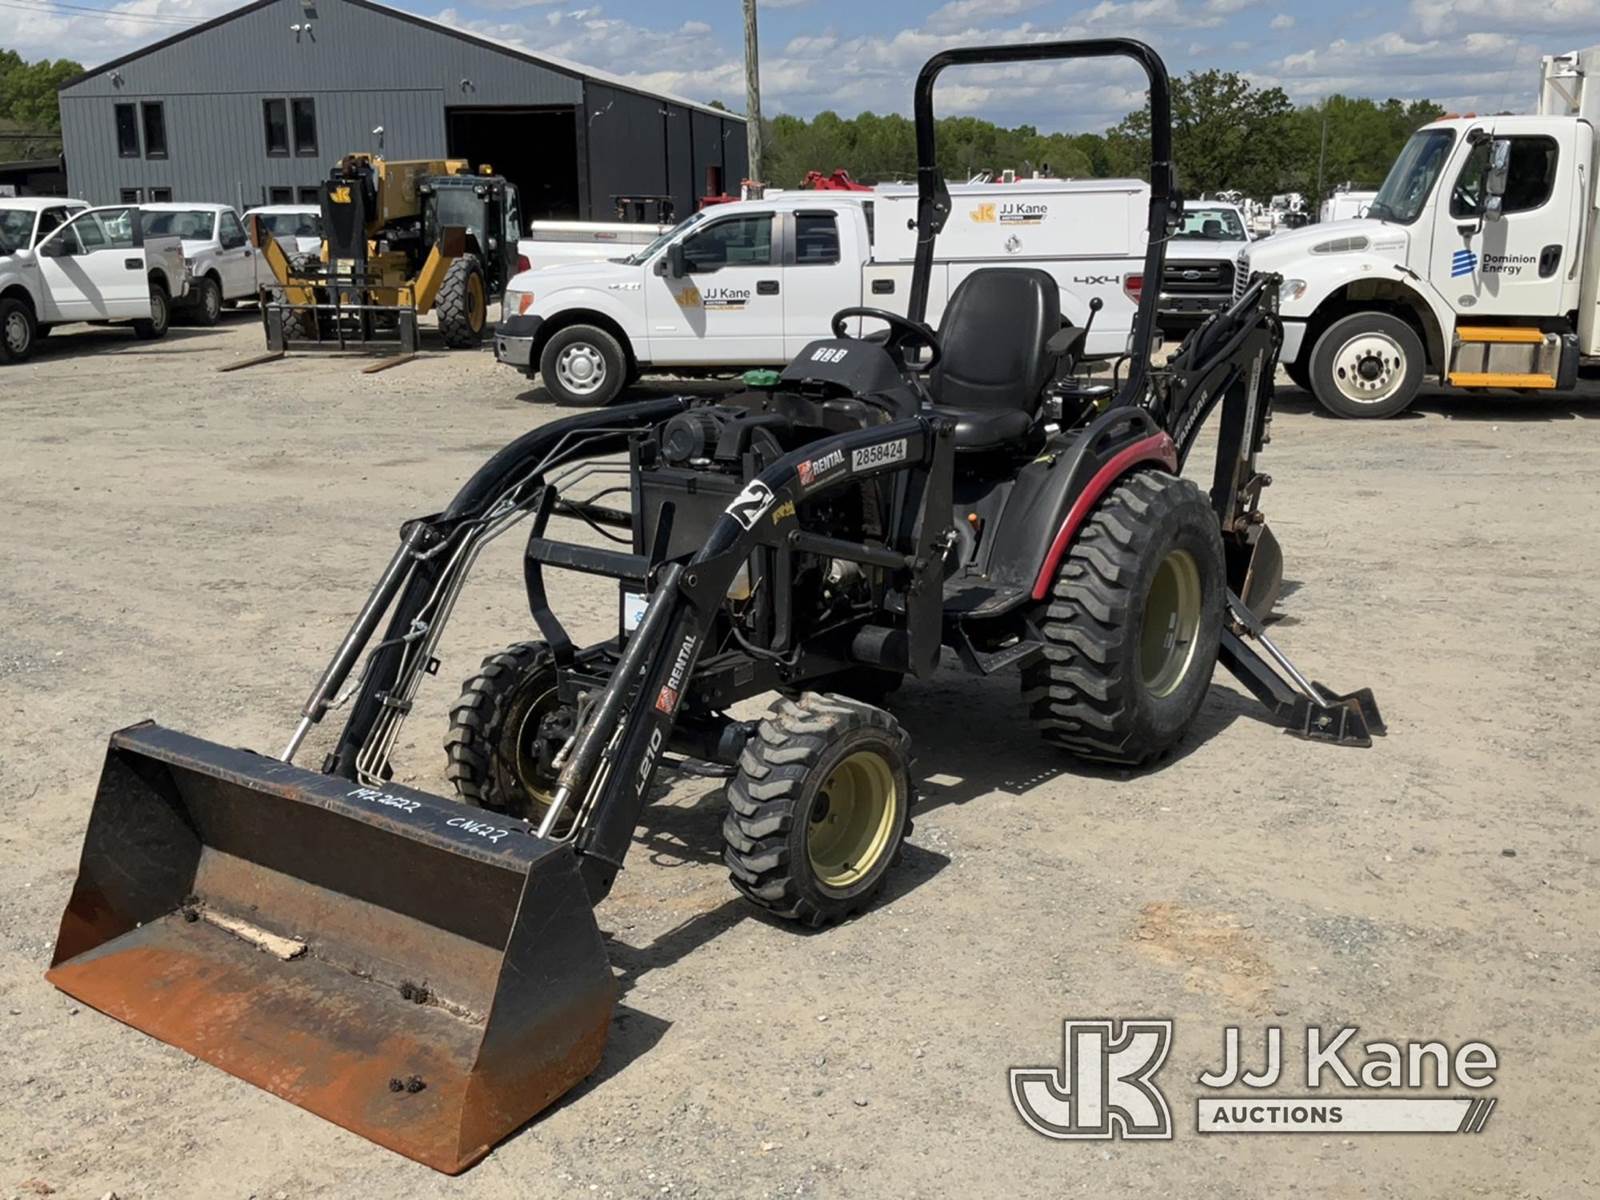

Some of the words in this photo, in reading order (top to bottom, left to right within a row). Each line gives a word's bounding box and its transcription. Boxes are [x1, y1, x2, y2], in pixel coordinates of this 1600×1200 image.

[1000, 203, 1013, 214] JJ
[1016, 203, 1048, 214] Kane
[1483, 254, 1536, 264] Dominion
[1482, 263, 1522, 276] Energy
[704, 287, 717, 299] JJ
[720, 287, 751, 299] Kane
[812, 449, 845, 476] RENTAL
[856, 441, 903, 466] 2858424
[667, 633, 697, 690] RENTAL
[446, 817, 509, 845] CN622
